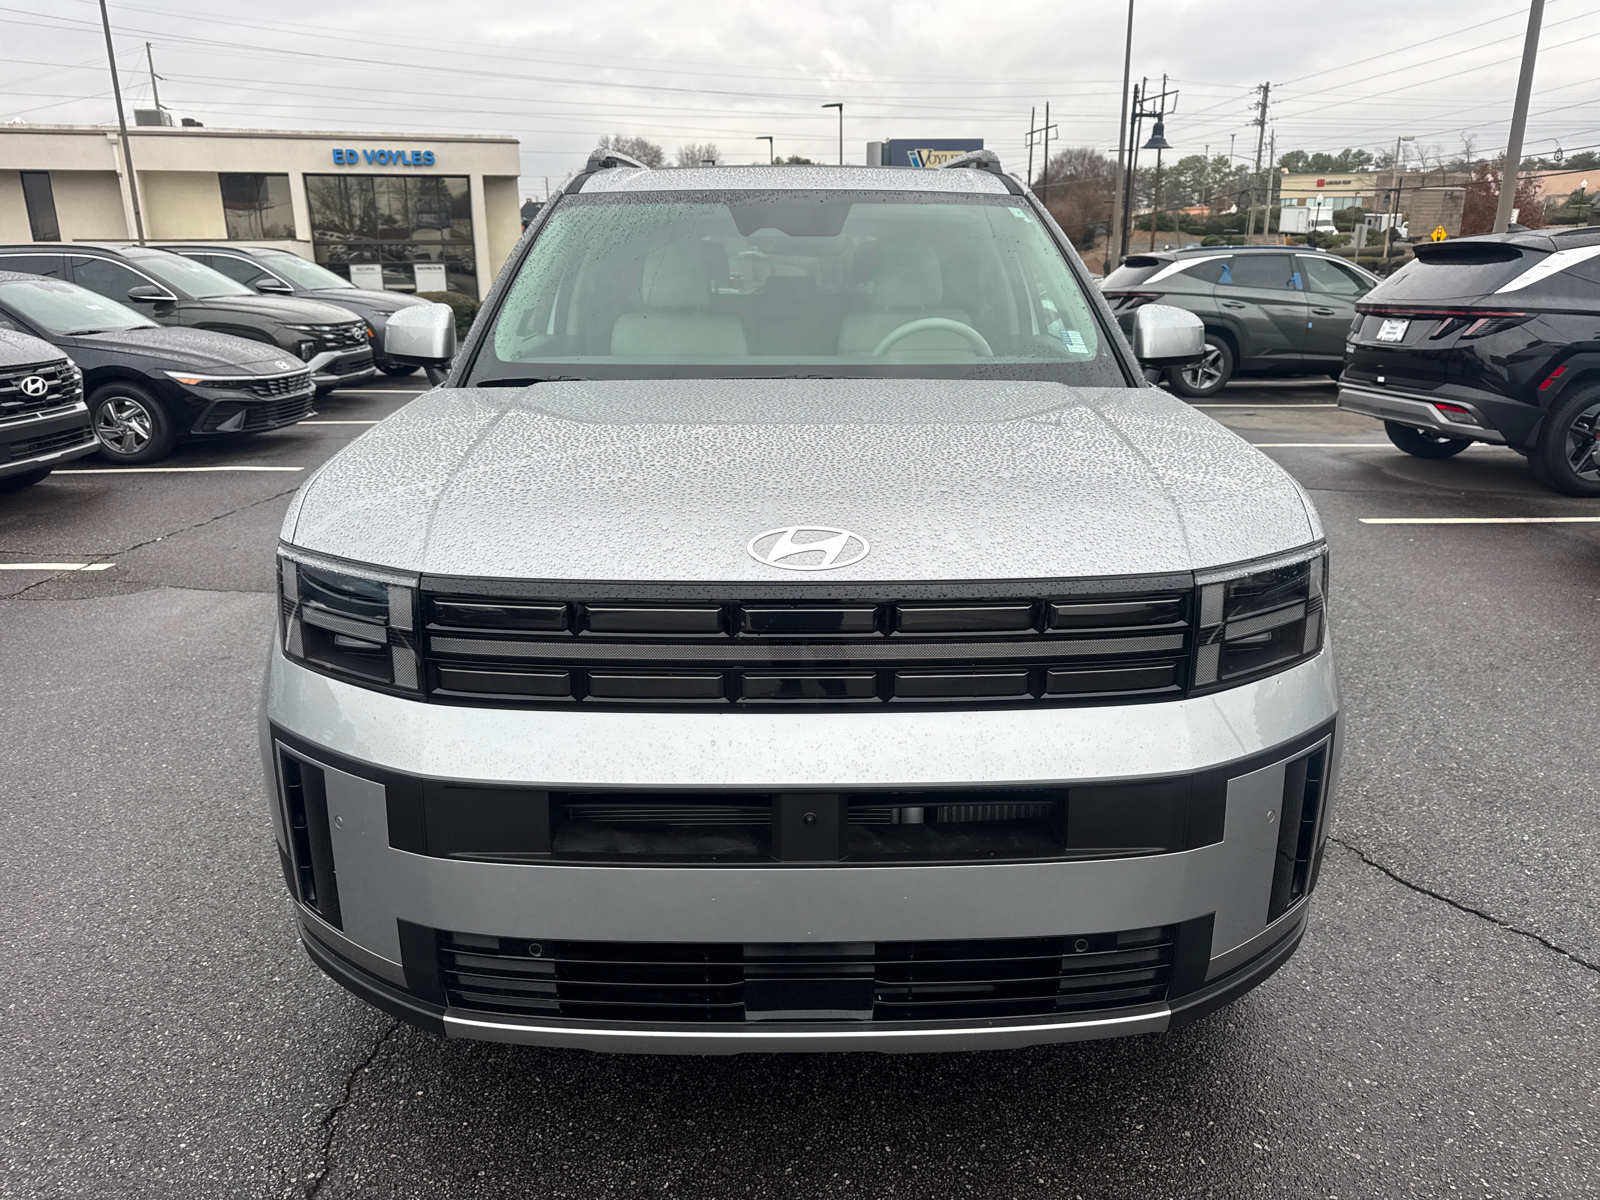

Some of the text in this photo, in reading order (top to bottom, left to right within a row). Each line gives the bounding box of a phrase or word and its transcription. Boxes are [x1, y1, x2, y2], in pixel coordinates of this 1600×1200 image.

[333, 149, 436, 166] ED VOYLES
[917, 150, 958, 167] VOYL
